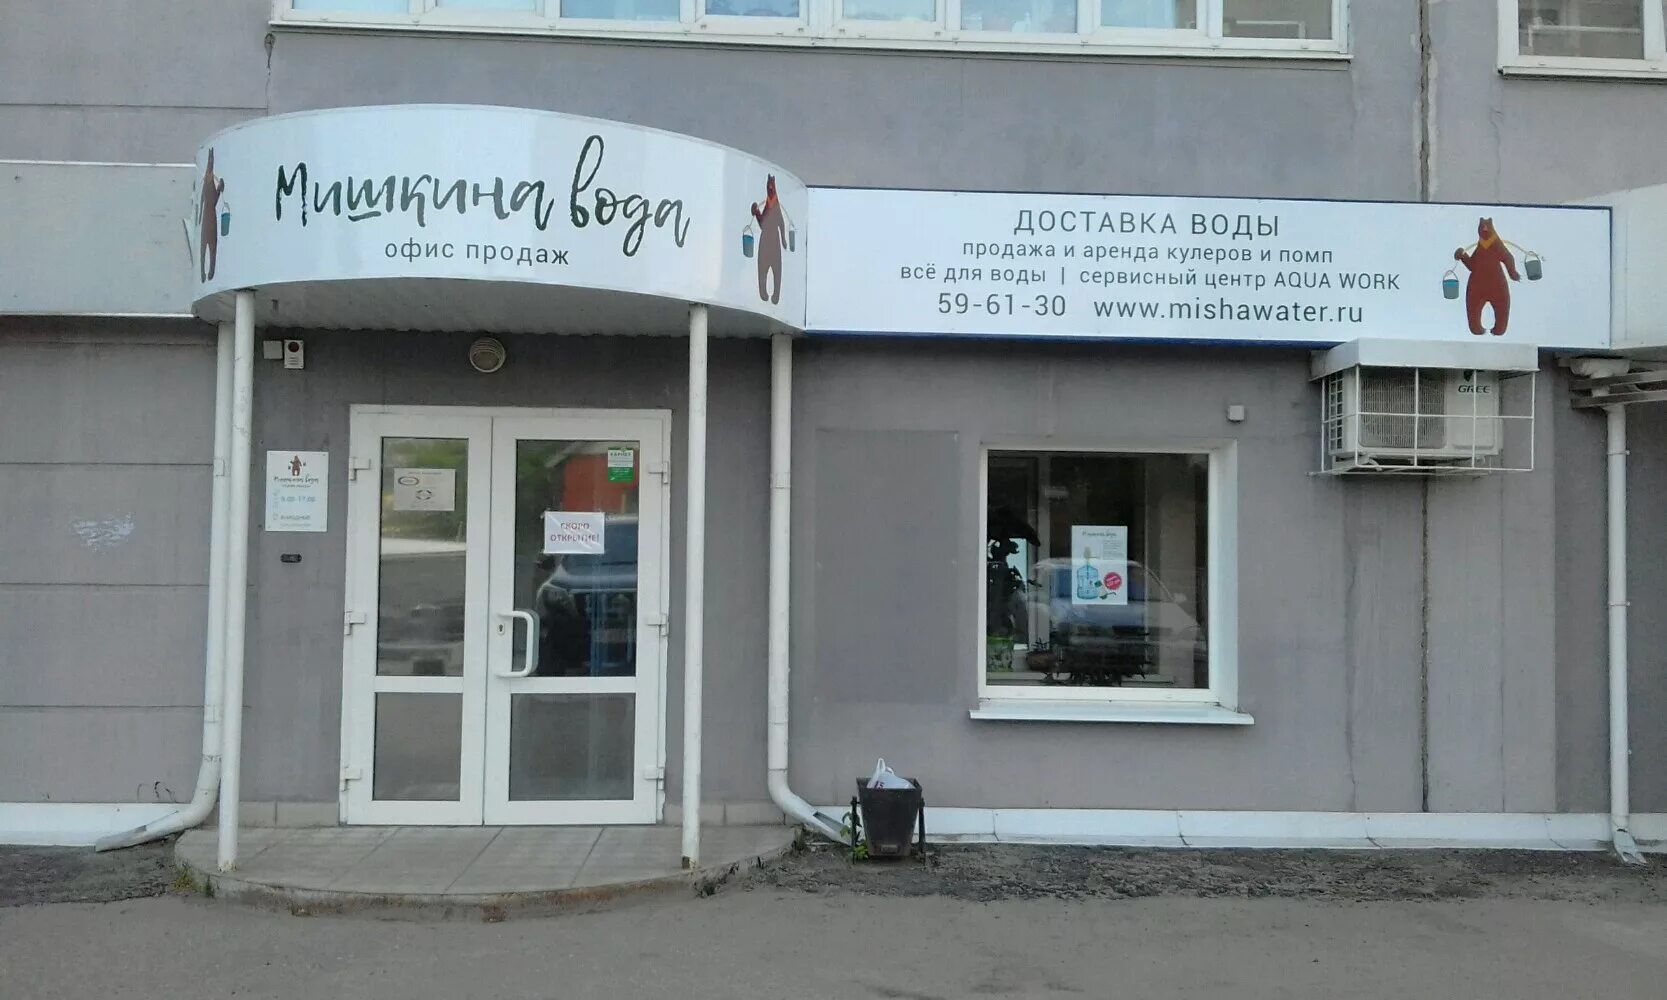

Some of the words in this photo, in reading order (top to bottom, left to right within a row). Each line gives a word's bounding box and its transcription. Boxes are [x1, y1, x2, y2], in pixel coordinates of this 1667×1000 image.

[275, 161, 555, 232] Мишкина
[570, 134, 691, 258] вода
[1014, 209, 1177, 237] ДОСТАВКА
[1191, 213, 1279, 241] ВОДЫ
[384, 237, 455, 263] офис
[466, 243, 569, 267] продаж
[962, 242, 1056, 260] продажа
[1064, 244, 1075, 258] и
[1083, 244, 1159, 264] аренда
[1167, 246, 1253, 265] кулеров
[1260, 249, 1271, 262] и
[1279, 249, 1333, 264] помп
[900, 262, 937, 280] всё
[943, 267, 982, 285] для
[990, 268, 1046, 286] воды
[1079, 268, 1197, 289] сервисный
[1204, 273, 1266, 292] центр
[1273, 271, 1332, 289] AQUA
[1338, 272, 1400, 291] WORK
[938, 292, 1066, 317] 59-61-30
[1093, 296, 1363, 323] www.mishawater.ru
